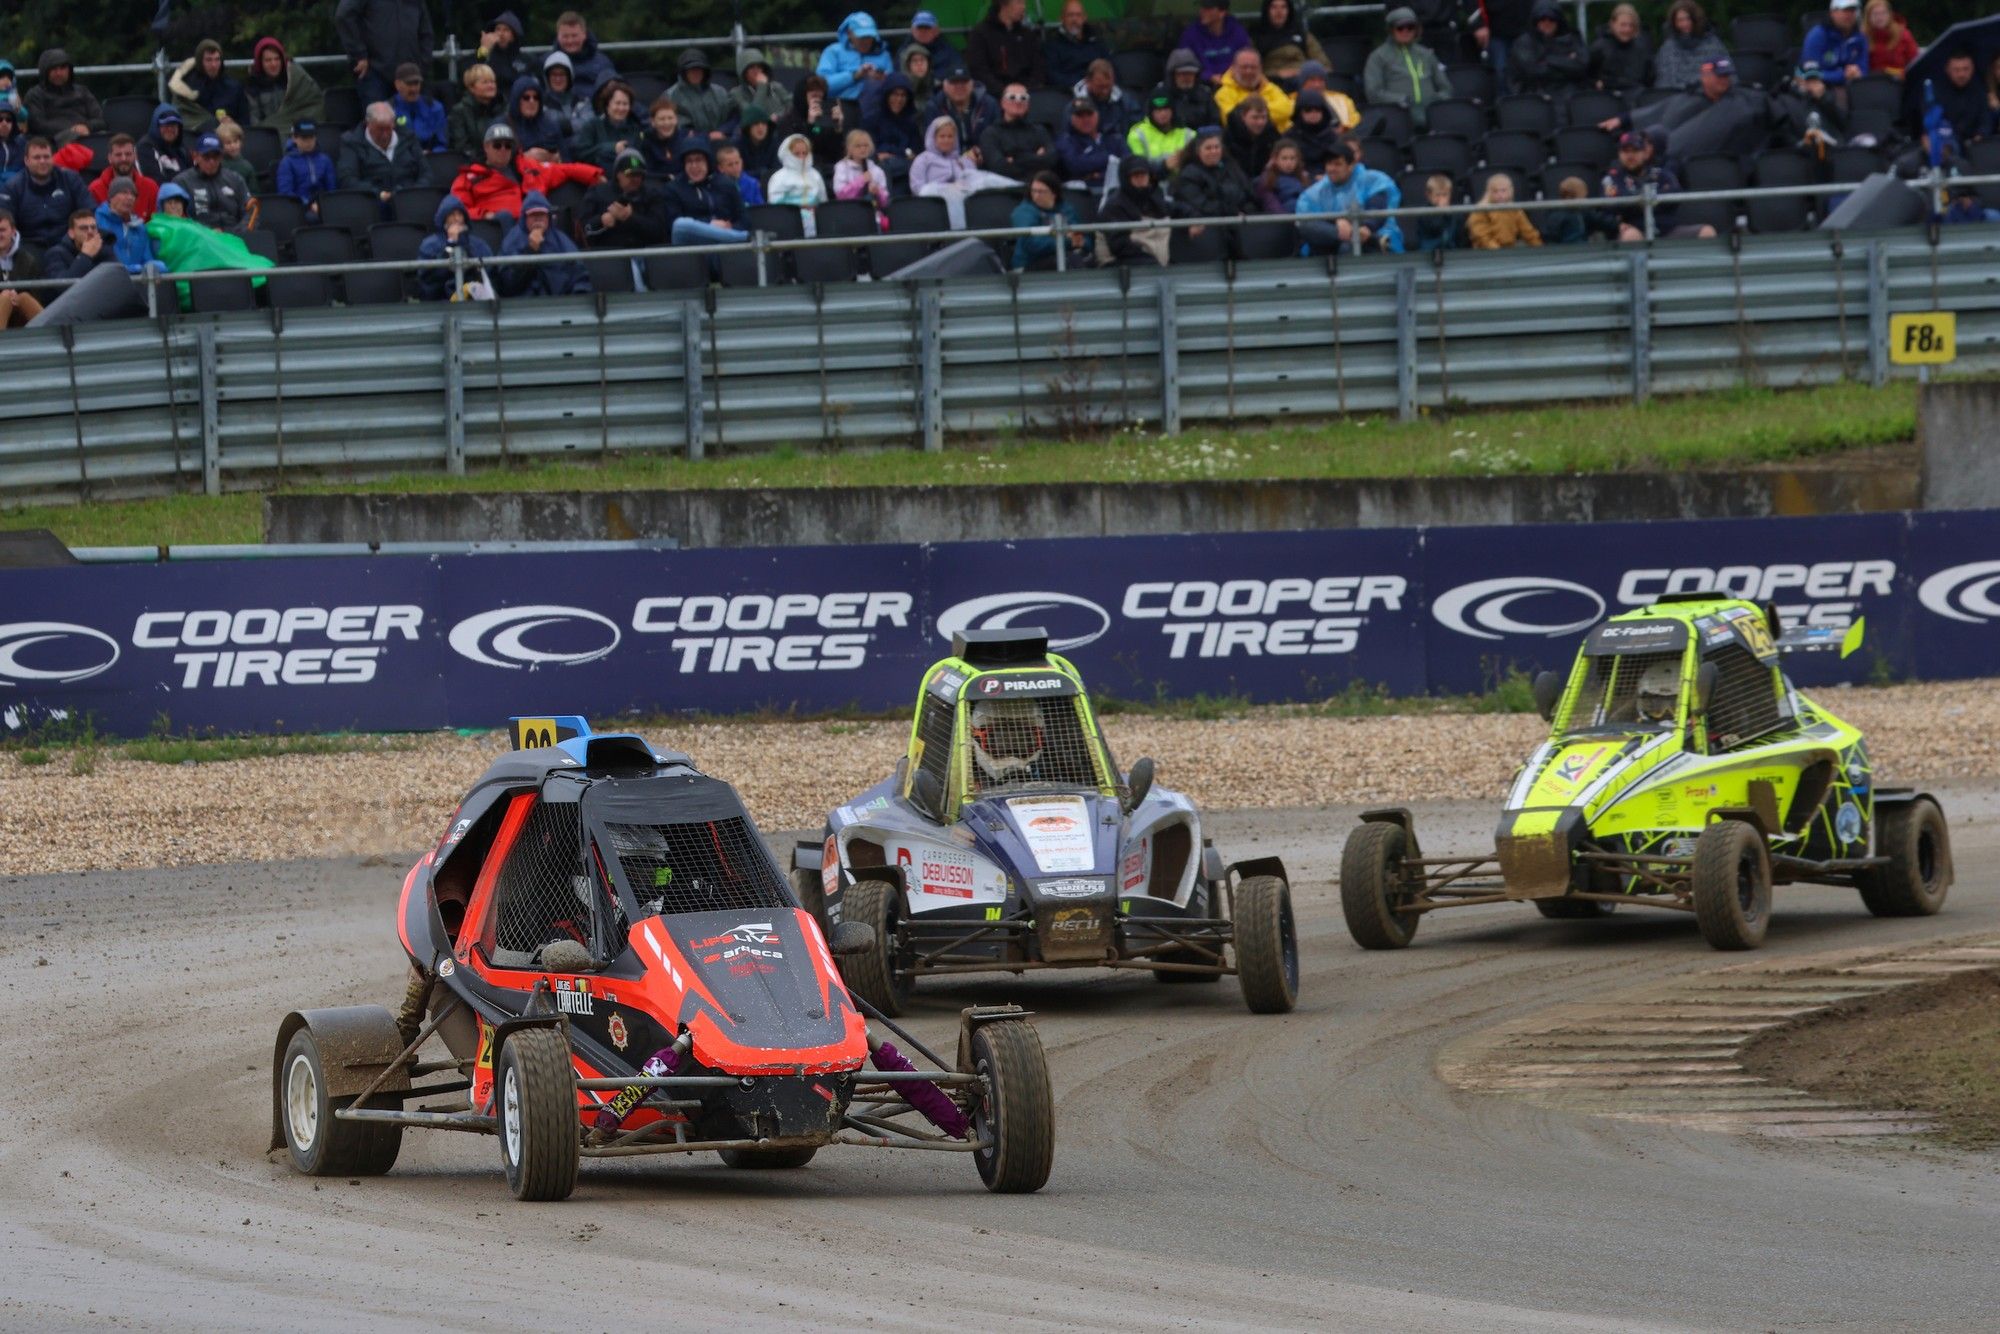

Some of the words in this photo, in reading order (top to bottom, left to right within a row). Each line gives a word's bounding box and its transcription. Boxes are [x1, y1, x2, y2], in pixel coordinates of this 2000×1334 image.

[1121, 575, 1408, 618] COOPER
[1617, 559, 1897, 605] COOPER
[132, 605, 424, 649] COOPER
[632, 592, 914, 633] COOPER
[671, 633, 872, 673] TIRES
[1161, 617, 1364, 659] TIRES
[173, 647, 381, 689] TIRES
[1004, 679, 1062, 691] PIRAGRI
[922, 862, 974, 886] DEBUISSON
[556, 990, 595, 1015] CARTELLE
